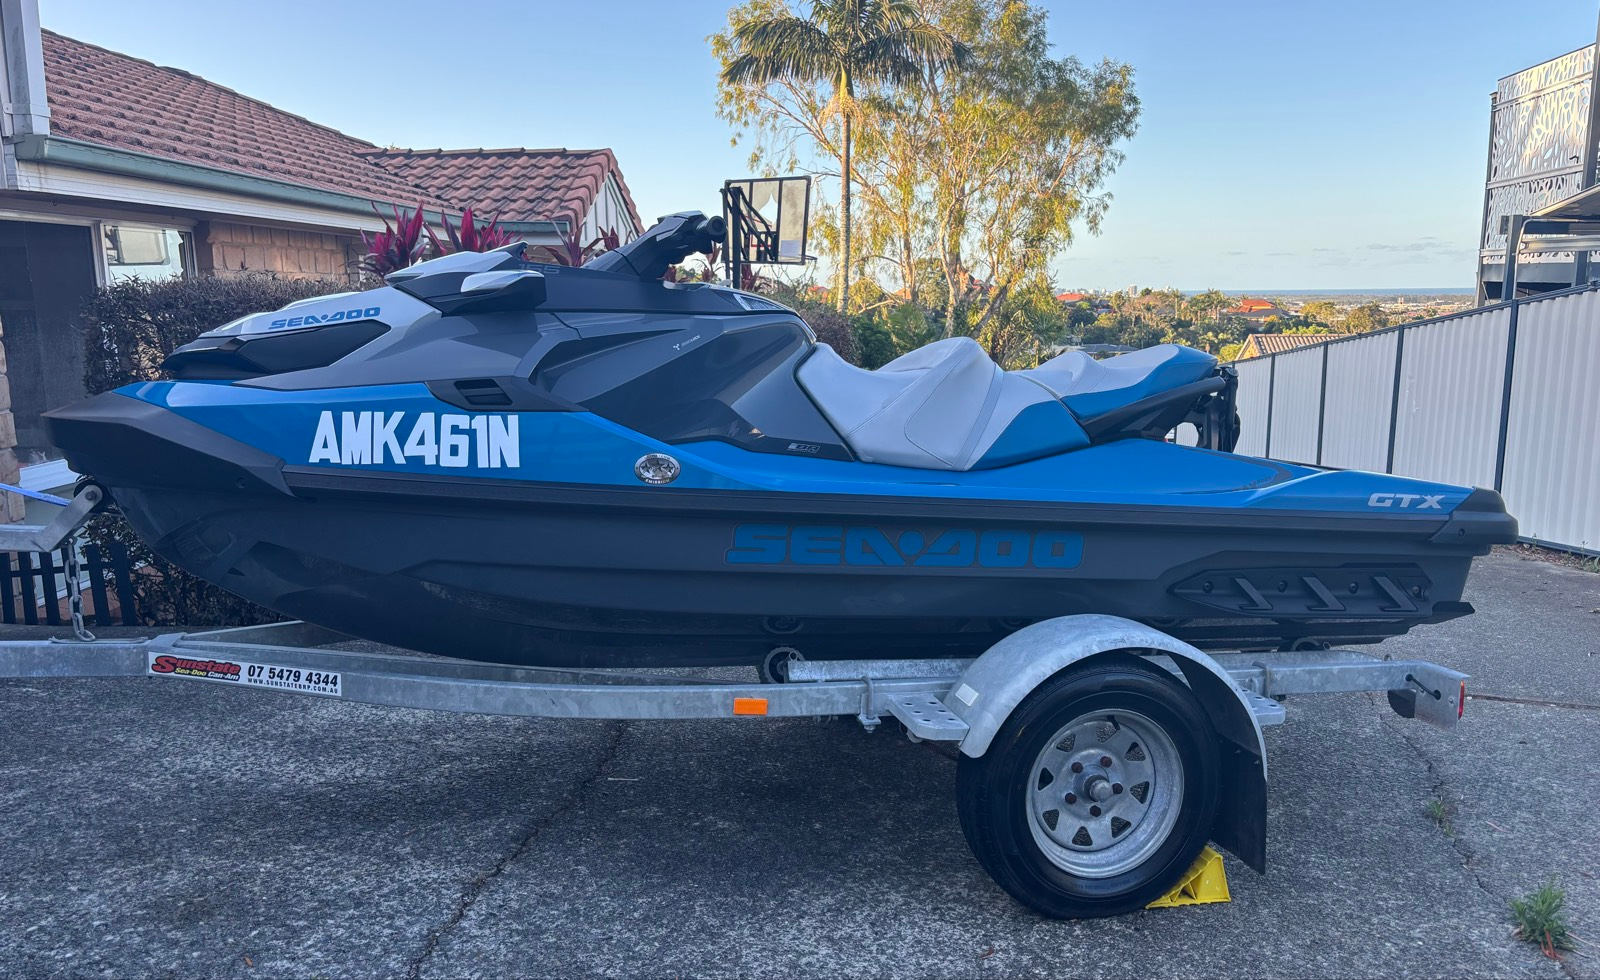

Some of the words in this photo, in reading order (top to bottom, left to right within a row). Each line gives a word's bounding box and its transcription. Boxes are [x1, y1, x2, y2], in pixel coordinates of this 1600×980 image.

[308, 410, 521, 469] AMK461N
[1367, 492, 1446, 509] GTX
[152, 656, 241, 675] Sunstate
[174, 667, 207, 677] Sea-Doo
[207, 671, 240, 681] Can-Am
[247, 664, 265, 678] 07
[268, 667, 302, 683] 5479
[305, 671, 339, 688] 4344
